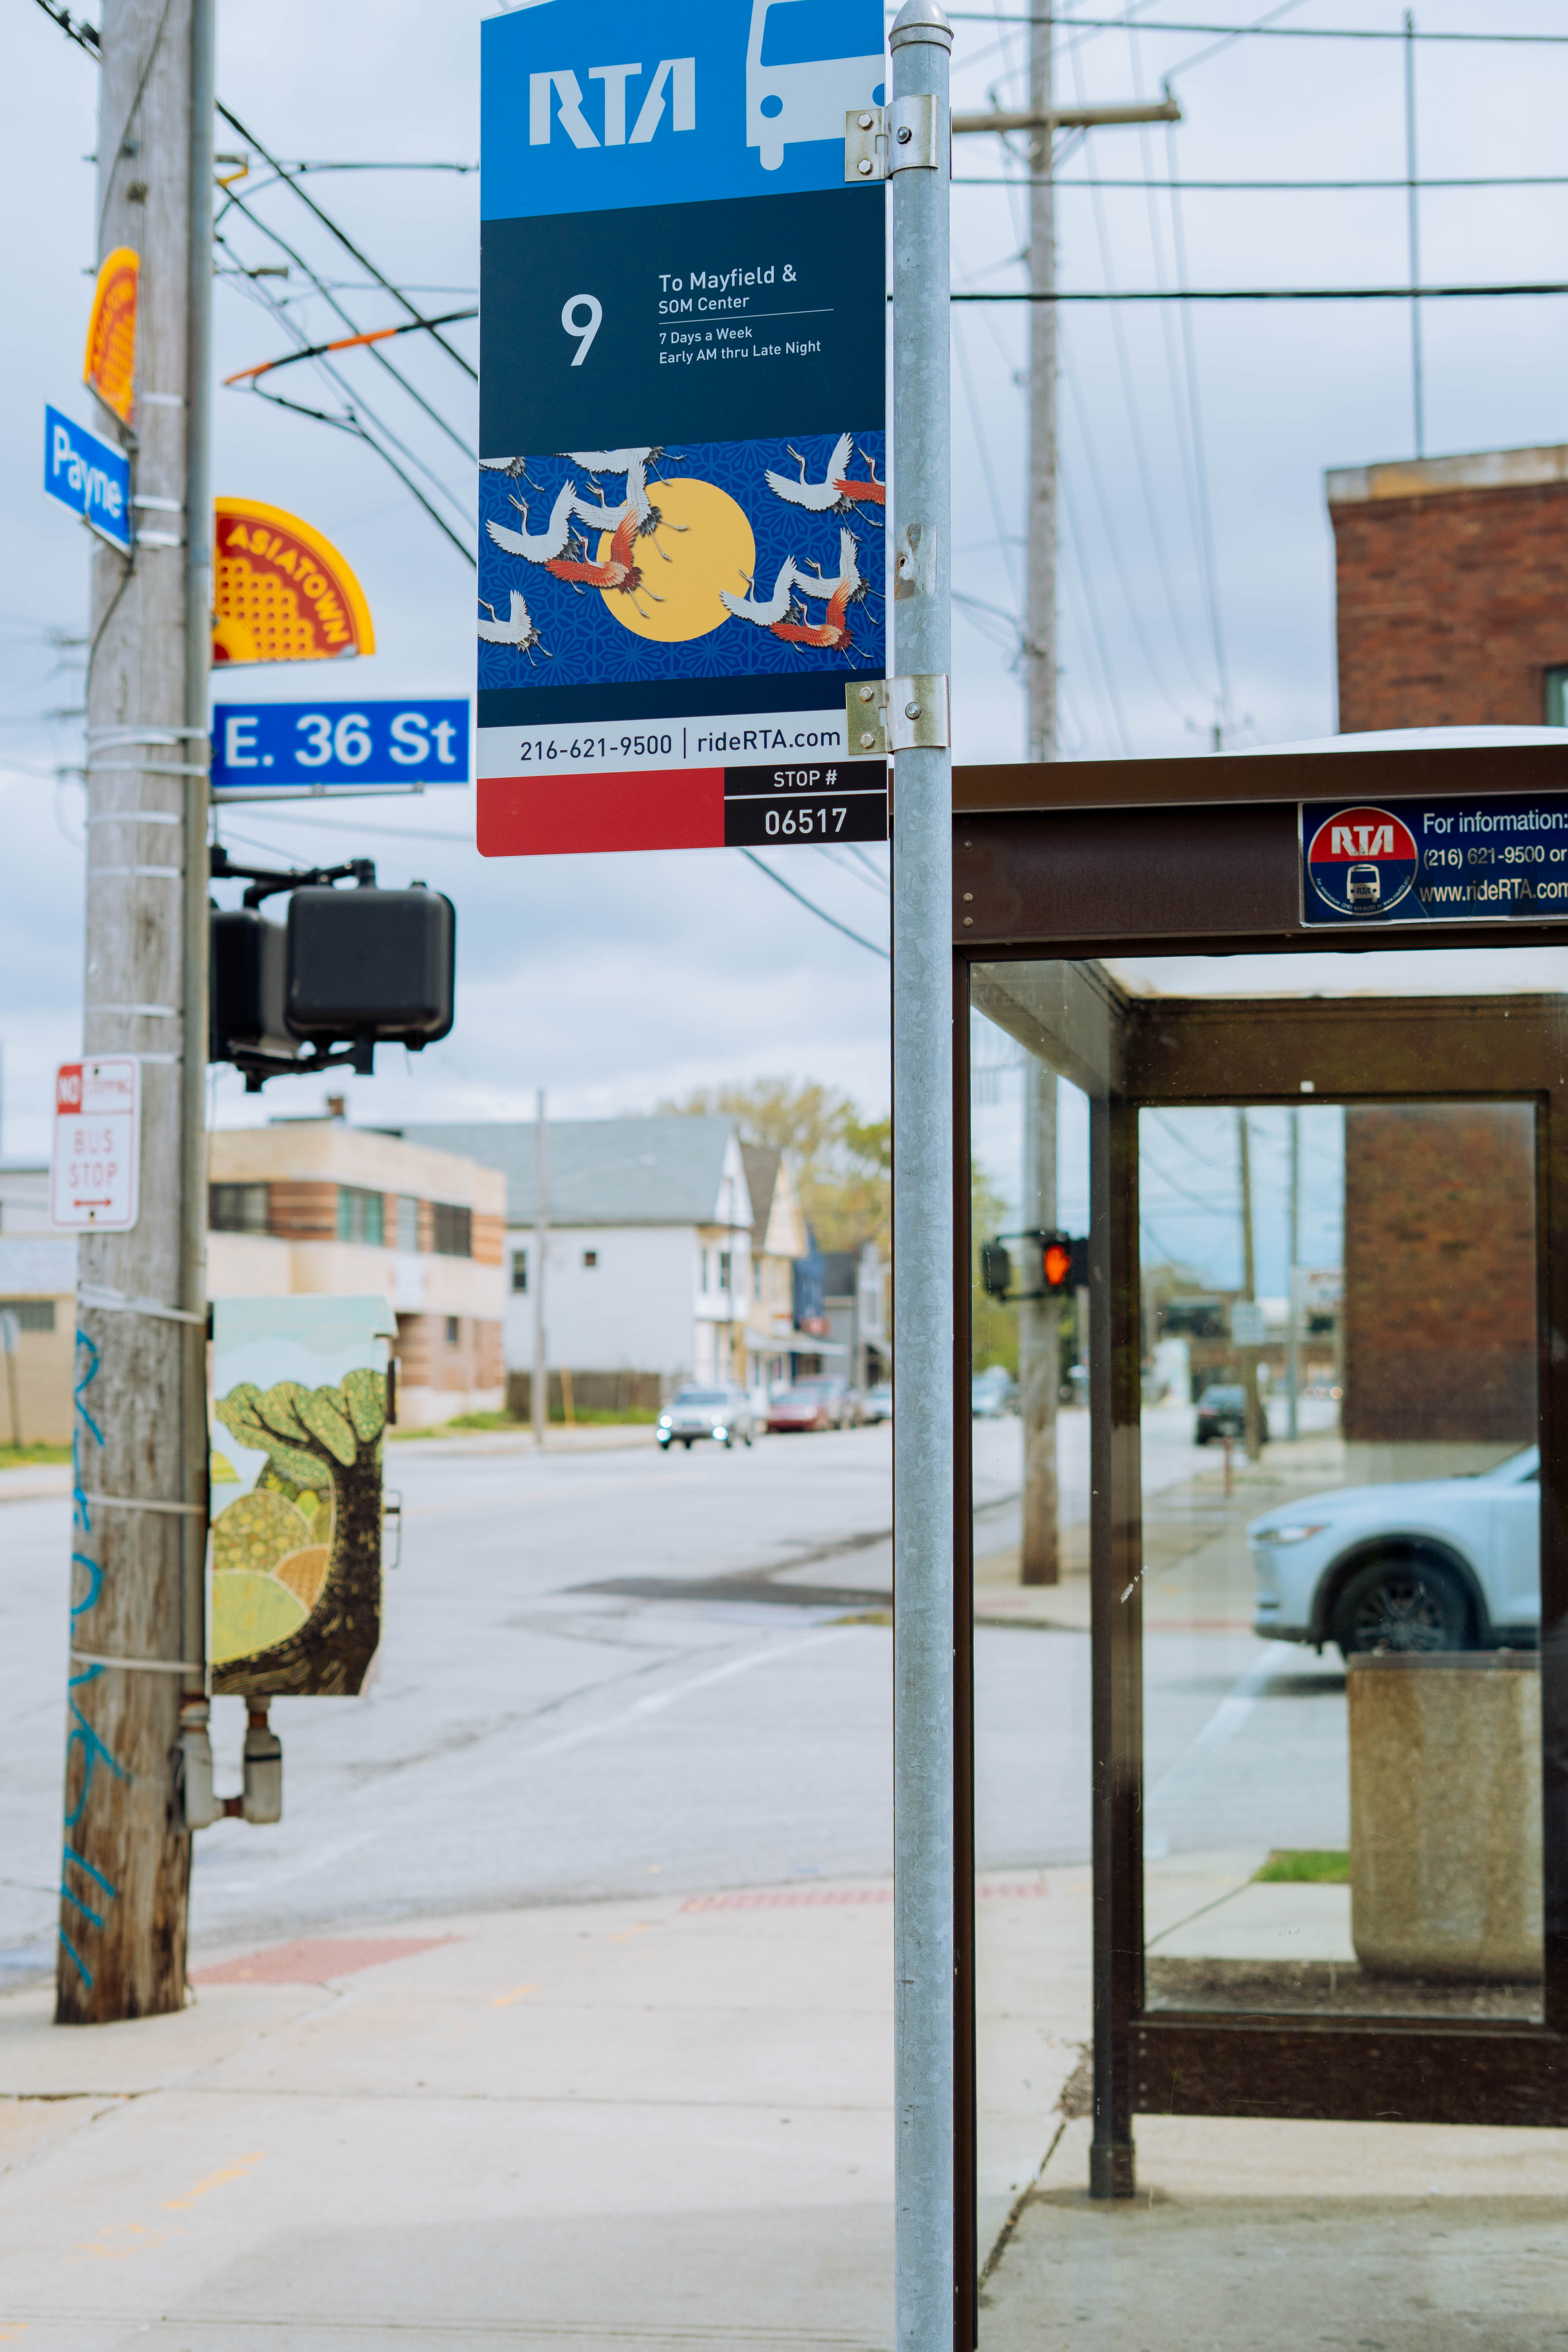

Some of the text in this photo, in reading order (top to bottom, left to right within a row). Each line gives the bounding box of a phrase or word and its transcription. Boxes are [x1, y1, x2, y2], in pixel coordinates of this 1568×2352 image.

[530, 57, 695, 149] RTA
[659, 264, 797, 292] To Mayfield &
[659, 297, 749, 314] SOM Center
[562, 294, 602, 366] 9
[660, 333, 666, 344] 7
[671, 332, 701, 345] Days
[716, 327, 752, 340] Week
[660, 341, 820, 364] Early AM thru Late Night
[54, 424, 123, 518] Payne
[226, 523, 351, 645] ASIATOWN
[226, 713, 455, 767] E. 36 St
[521, 729, 840, 760] 216-621-9500 rideRTA.com
[774, 770, 837, 787] STOP #
[766, 808, 846, 835] 06517
[1424, 809, 1568, 833] For information:
[1332, 825, 1393, 856] RTA
[1424, 845, 1567, 870] (216) 621-9500 or
[57, 1075, 81, 1104] NO
[74, 1130, 113, 1154] BUS
[69, 1161, 118, 1188] STOP
